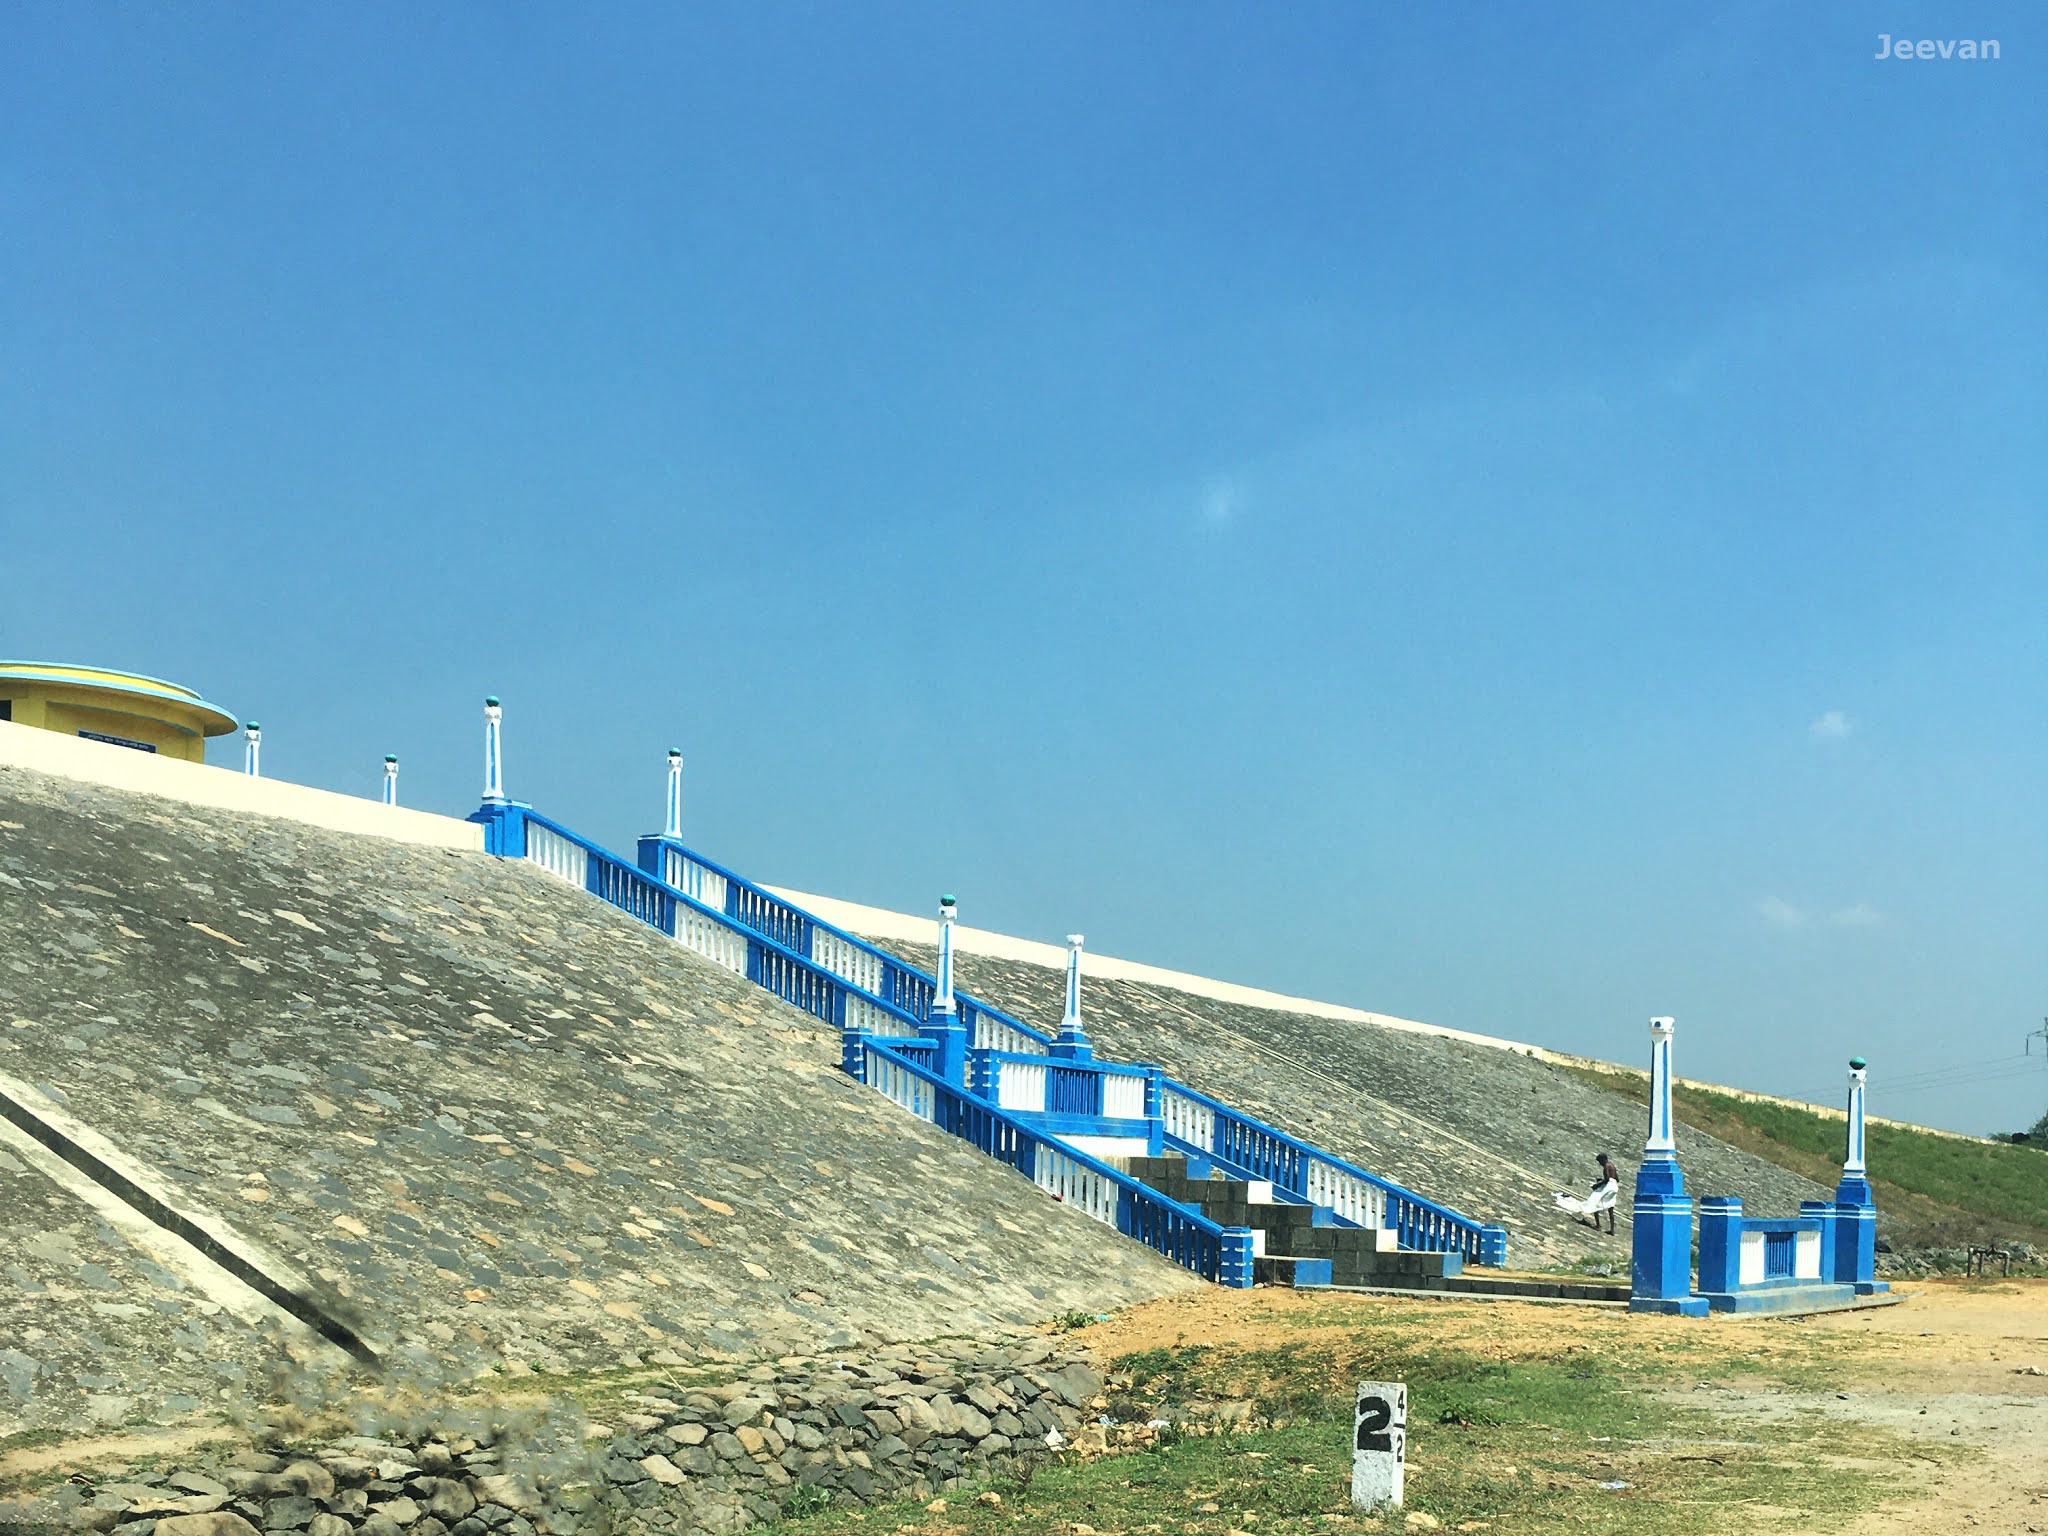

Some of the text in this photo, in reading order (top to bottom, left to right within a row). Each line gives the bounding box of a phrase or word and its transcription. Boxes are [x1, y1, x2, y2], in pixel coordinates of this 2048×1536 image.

[1397, 1390, 1405, 1417] 4
[1357, 1396, 1392, 1452] 2
[1396, 1433, 1403, 1463] 2
